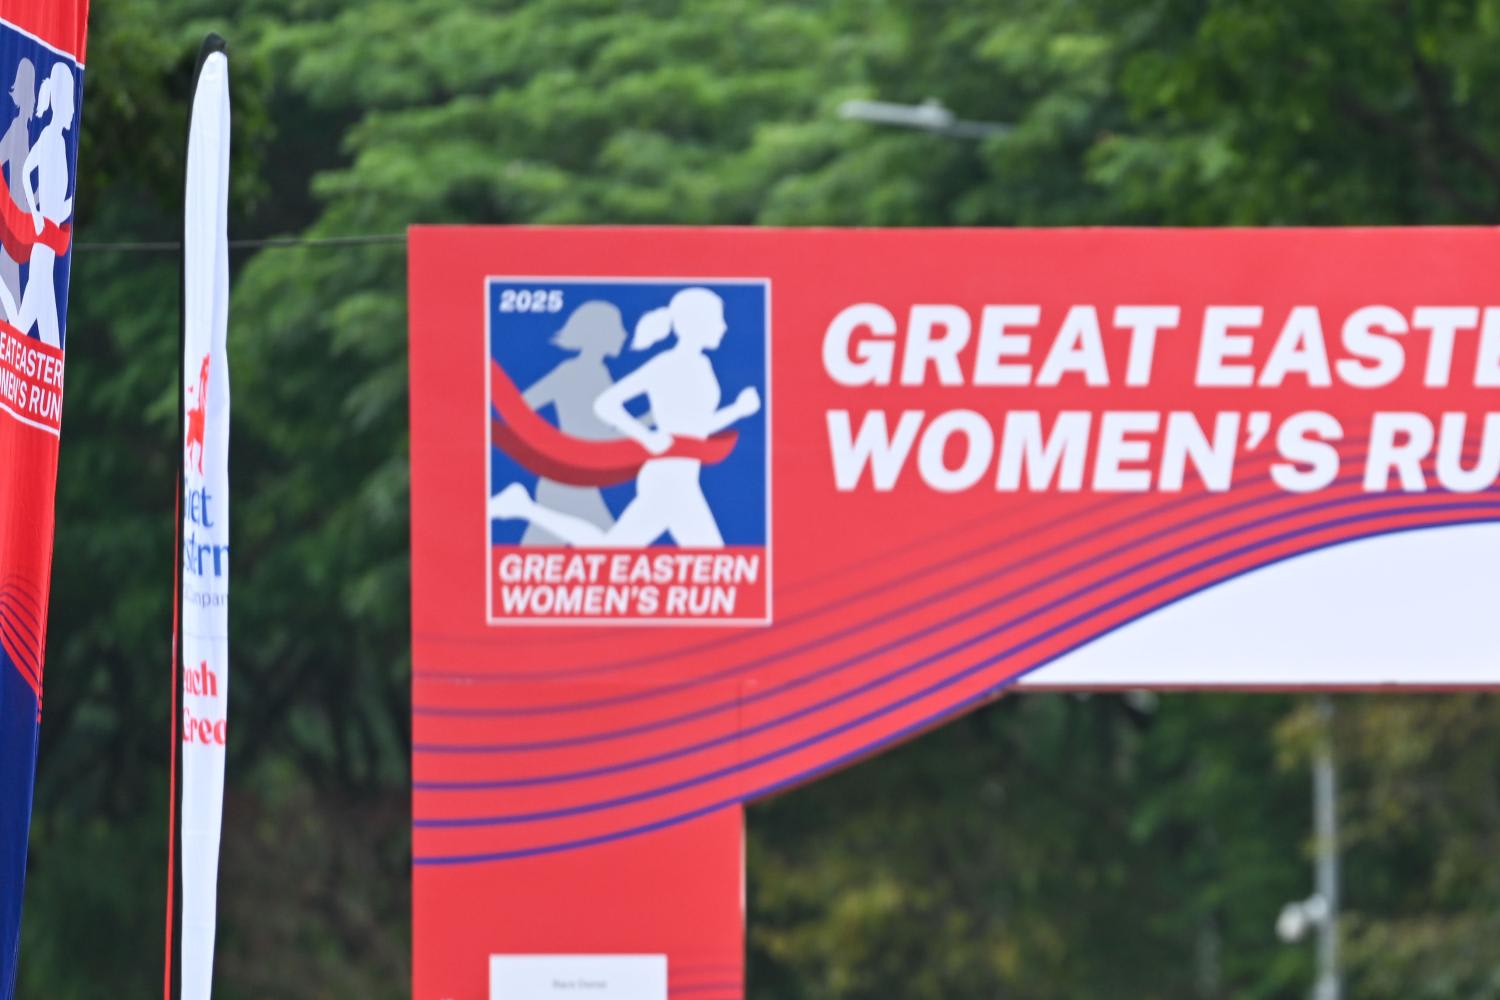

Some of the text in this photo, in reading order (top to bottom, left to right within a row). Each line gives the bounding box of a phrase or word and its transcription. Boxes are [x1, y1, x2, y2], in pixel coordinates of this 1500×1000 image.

[500, 290, 564, 313] 2025
[0, 331, 63, 388] EAT EASTER
[821, 303, 1180, 388] GREAT
[29, 384, 60, 422] RUN
[826, 409, 1344, 493] WOMEN'S
[500, 554, 759, 584] GREAT EASTERN
[500, 586, 737, 615] WOMEN'S RUN
